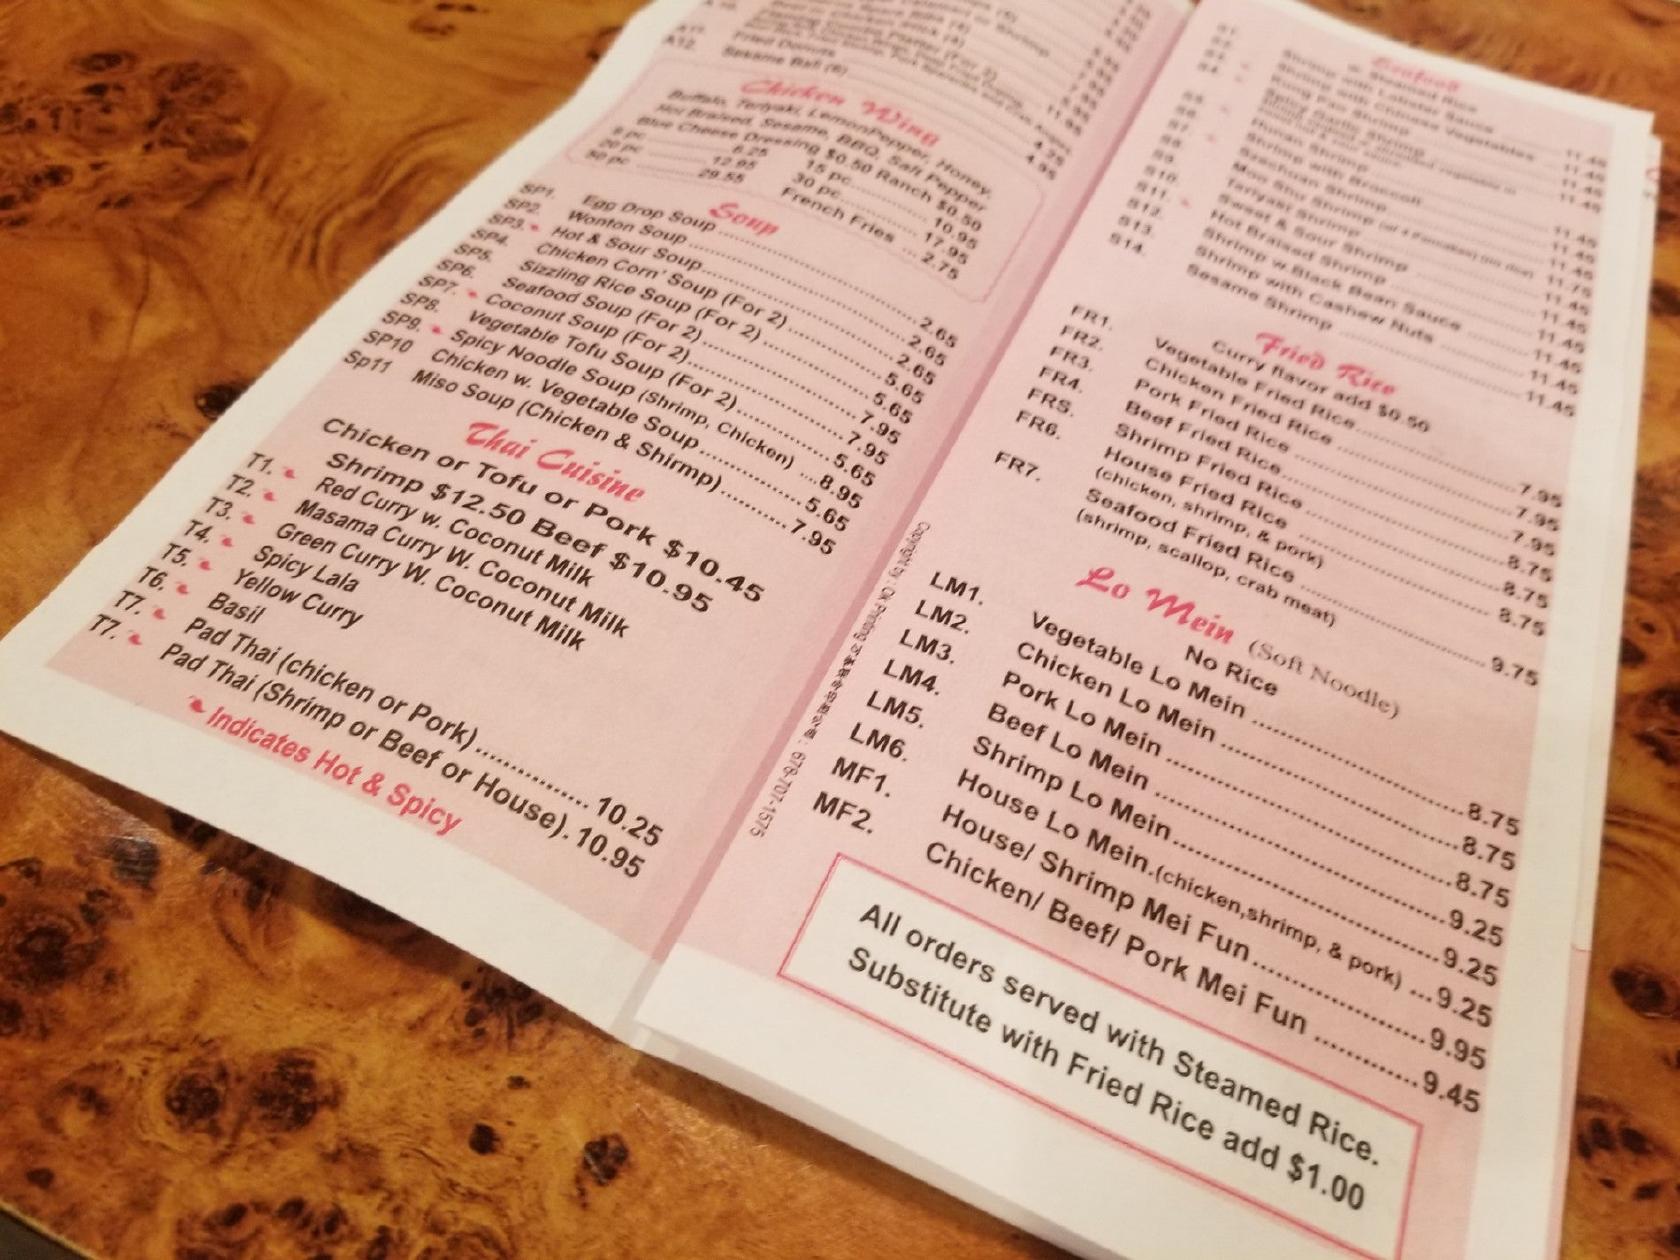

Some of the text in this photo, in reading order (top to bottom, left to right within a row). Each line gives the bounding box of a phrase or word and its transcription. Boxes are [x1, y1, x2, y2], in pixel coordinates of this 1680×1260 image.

[707, 201, 780, 237] Soup
[778, 184, 961, 282] French Fries 2.75
[550, 224, 586, 243] Hot
[584, 231, 602, 246] &
[603, 235, 652, 256] Sour
[651, 246, 704, 273] Soup
[894, 351, 937, 387] 2.65
[1210, 338, 1268, 373] Curry
[1270, 362, 1330, 395] flavor
[1331, 390, 1373, 412] add
[1254, 331, 1397, 396] Fried Rice
[360, 327, 851, 533] SP10 Chicken w. Vegetable Soup 5.65
[409, 367, 460, 394] Miso
[460, 381, 517, 412] Soup
[514, 398, 611, 443] (Chicken
[611, 431, 633, 451] &
[789, 516, 838, 557] 7.95
[448, 327, 507, 357] Spicy
[505, 342, 579, 377] Noodle
[579, 366, 637, 398] Soup
[715, 420, 796, 472] Chicken)
[817, 472, 865, 510] 8.95
[463, 420, 646, 503] Thai Cuisine
[1154, 335, 1250, 387] Vegetable
[1252, 378, 1307, 411] Fried
[1308, 402, 1357, 430] Rice
[1519, 482, 1564, 509] 7.95
[182, 517, 361, 594] T4. Spicy Lala
[245, 450, 596, 589] T1. Red Curry w. Coconut Milk
[321, 416, 766, 604] Chicken or Tofu or Pork $10.45
[324, 451, 715, 614] Shrimp $12.50 Beef $10.95
[992, 449, 1540, 688] FR7. Seafood Fried Rice 9.75
[136, 564, 268, 625] T6. Basil
[1073, 565, 1401, 721] Lo Mein (Soft Noodle)
[1183, 643, 1280, 698] No Rice
[1235, 573, 1280, 601] crab
[1281, 592, 1337, 629] meat)
[87, 612, 123, 641] T7.
[158, 641, 211, 673] Pad
[205, 657, 261, 693] Thai
[250, 678, 348, 732] (Shrimp
[346, 719, 381, 742] or
[376, 727, 446, 770] Beef
[439, 760, 474, 785] or
[575, 825, 647, 879] 10.95
[112, 588, 665, 848] T7. Pad Thai (chicken or Pork) 10.25
[204, 704, 464, 838] Indicates Hot & Spicy
[927, 569, 1522, 838] LM1. Vegetable Lo Mein 8.75
[829, 754, 1488, 1072] MF1. House/ Shrimp Mei Fun 9.95
[865, 688, 925, 731] LM5.
[971, 734, 1065, 794] Shrimp
[1068, 778, 1105, 810] Lo
[1107, 795, 1173, 842] Mein
[1441, 945, 1500, 988] 9.25
[811, 789, 1482, 1114] MF2. Chicken/ Beef/ Pork Mei Fun 9.45
[857, 902, 1380, 1168] All orders served with Steamed Rice.
[846, 945, 1366, 1212] Substitute with Fried Rice add $1.00
